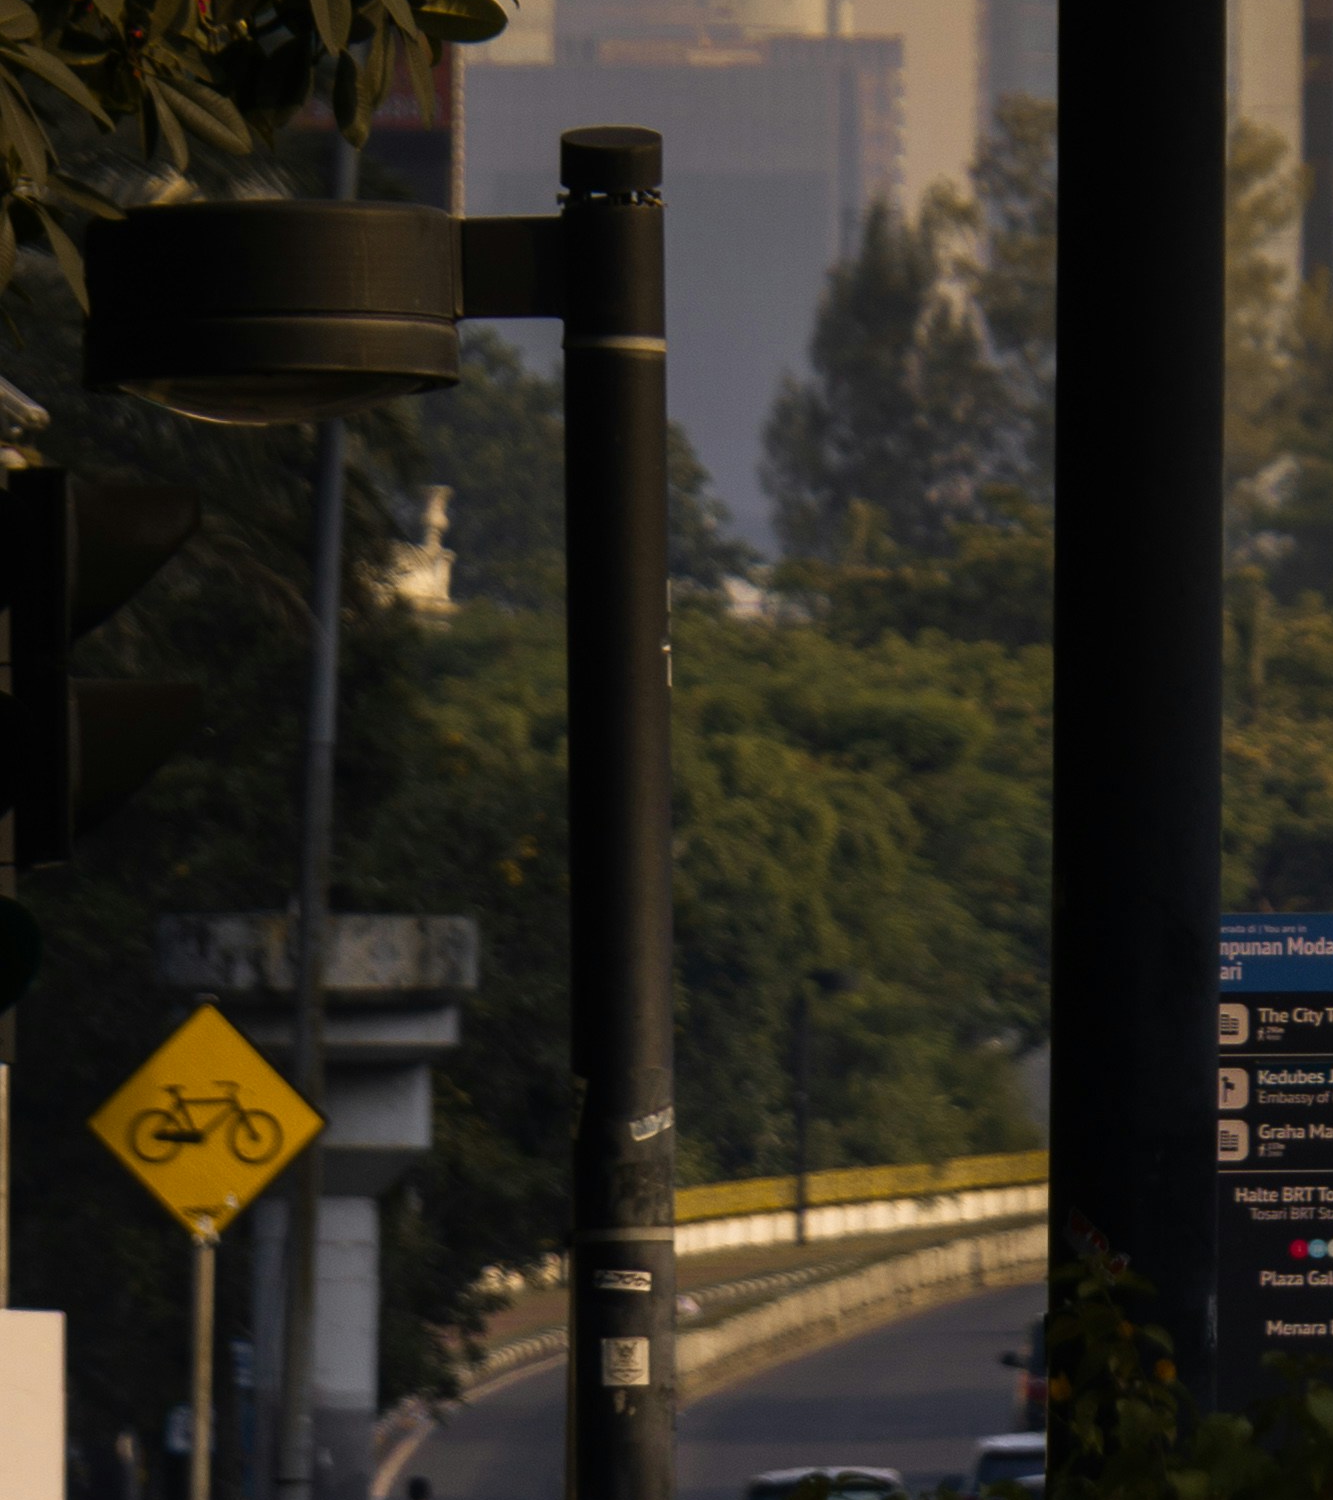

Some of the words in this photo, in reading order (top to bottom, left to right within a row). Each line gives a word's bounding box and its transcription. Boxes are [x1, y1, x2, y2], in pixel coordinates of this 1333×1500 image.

[1219, 961, 1243, 981] ari
[1256, 1007, 1290, 1024] The
[1291, 1007, 1324, 1027] City
[1256, 1069, 1326, 1086] Kedubes
[1256, 1089, 1315, 1107] Embassy
[1315, 1089, 1331, 1104] of
[1257, 1123, 1307, 1140] Graha
[1233, 1186, 1280, 1203] Halte
[1281, 1186, 1316, 1202] BRT
[1248, 1206, 1288, 1221] Tosari
[1289, 1206, 1317, 1221] BRT
[1259, 1269, 1305, 1287] Plaza
[1265, 1319, 1328, 1337] Menara
